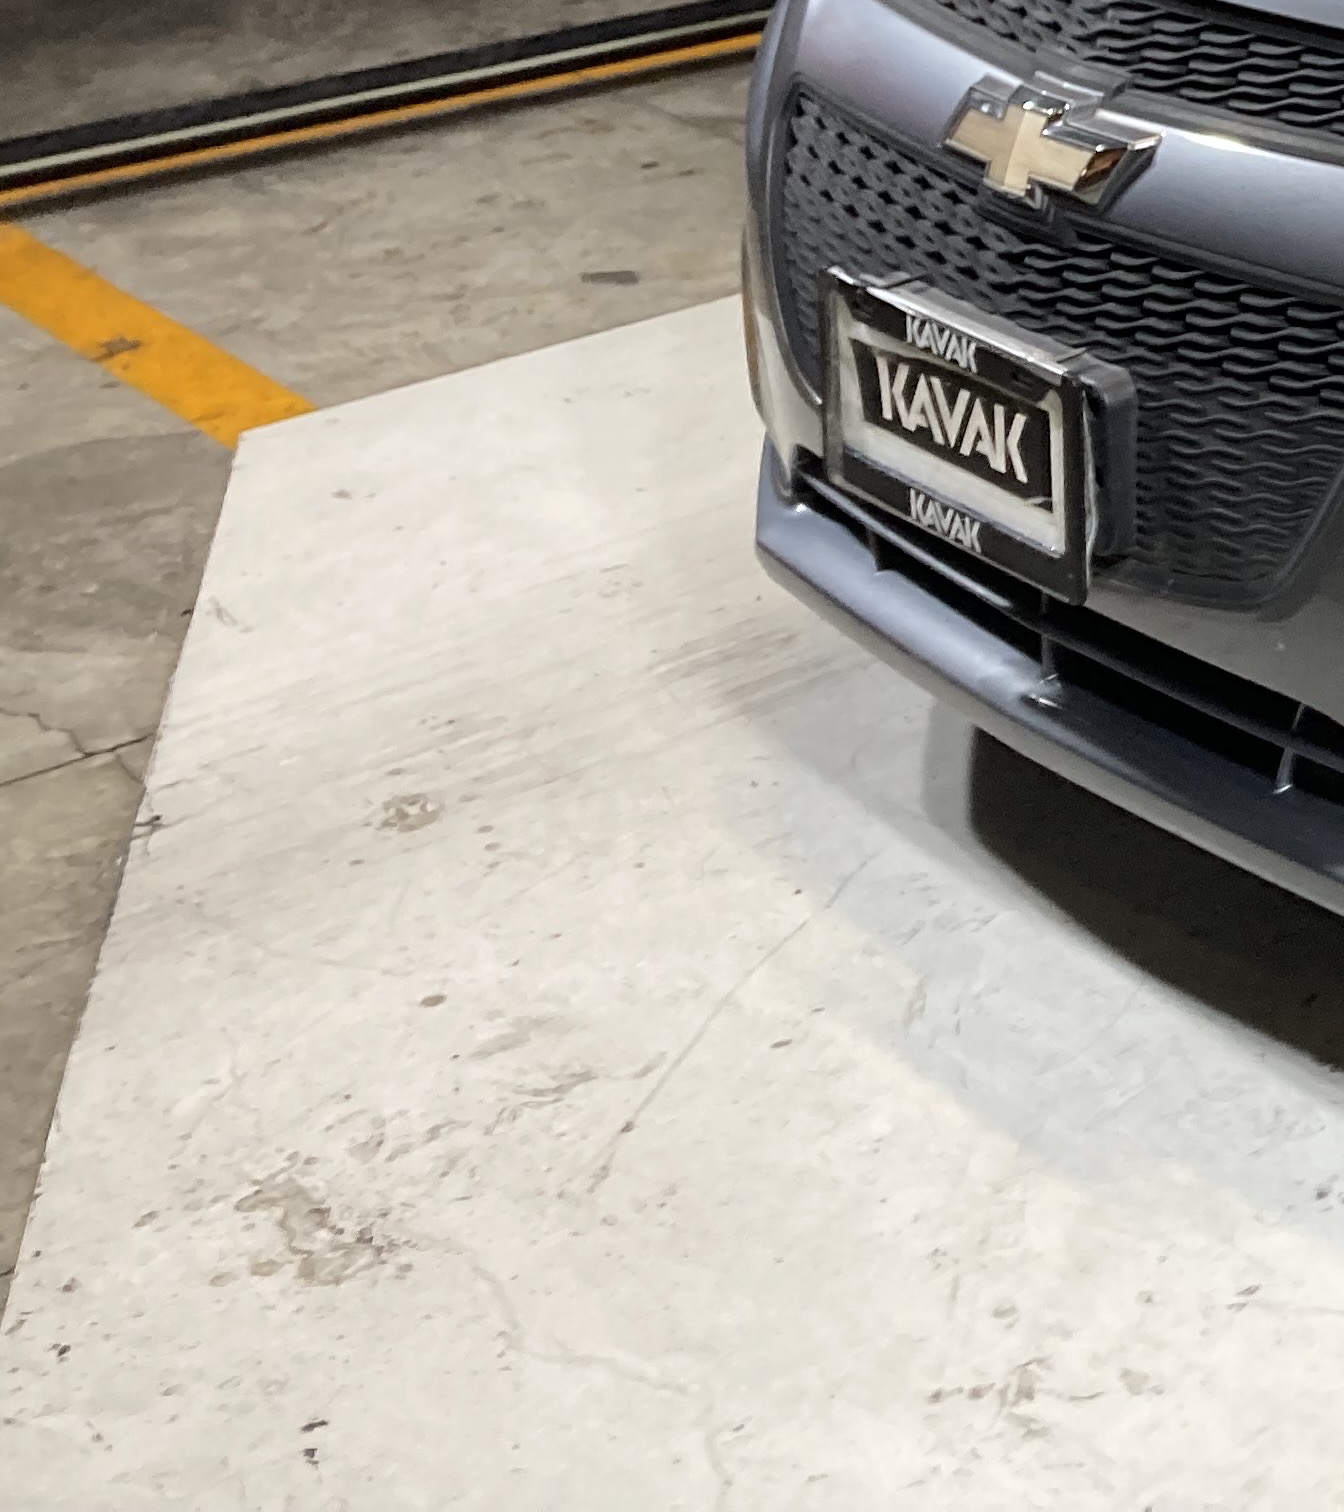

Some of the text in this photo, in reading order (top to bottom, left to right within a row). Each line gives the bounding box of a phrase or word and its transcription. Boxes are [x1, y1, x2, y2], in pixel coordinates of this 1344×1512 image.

[906, 314, 978, 374] KAVAK
[875, 355, 1028, 483] KAVAK
[910, 487, 982, 553] KAVAK
